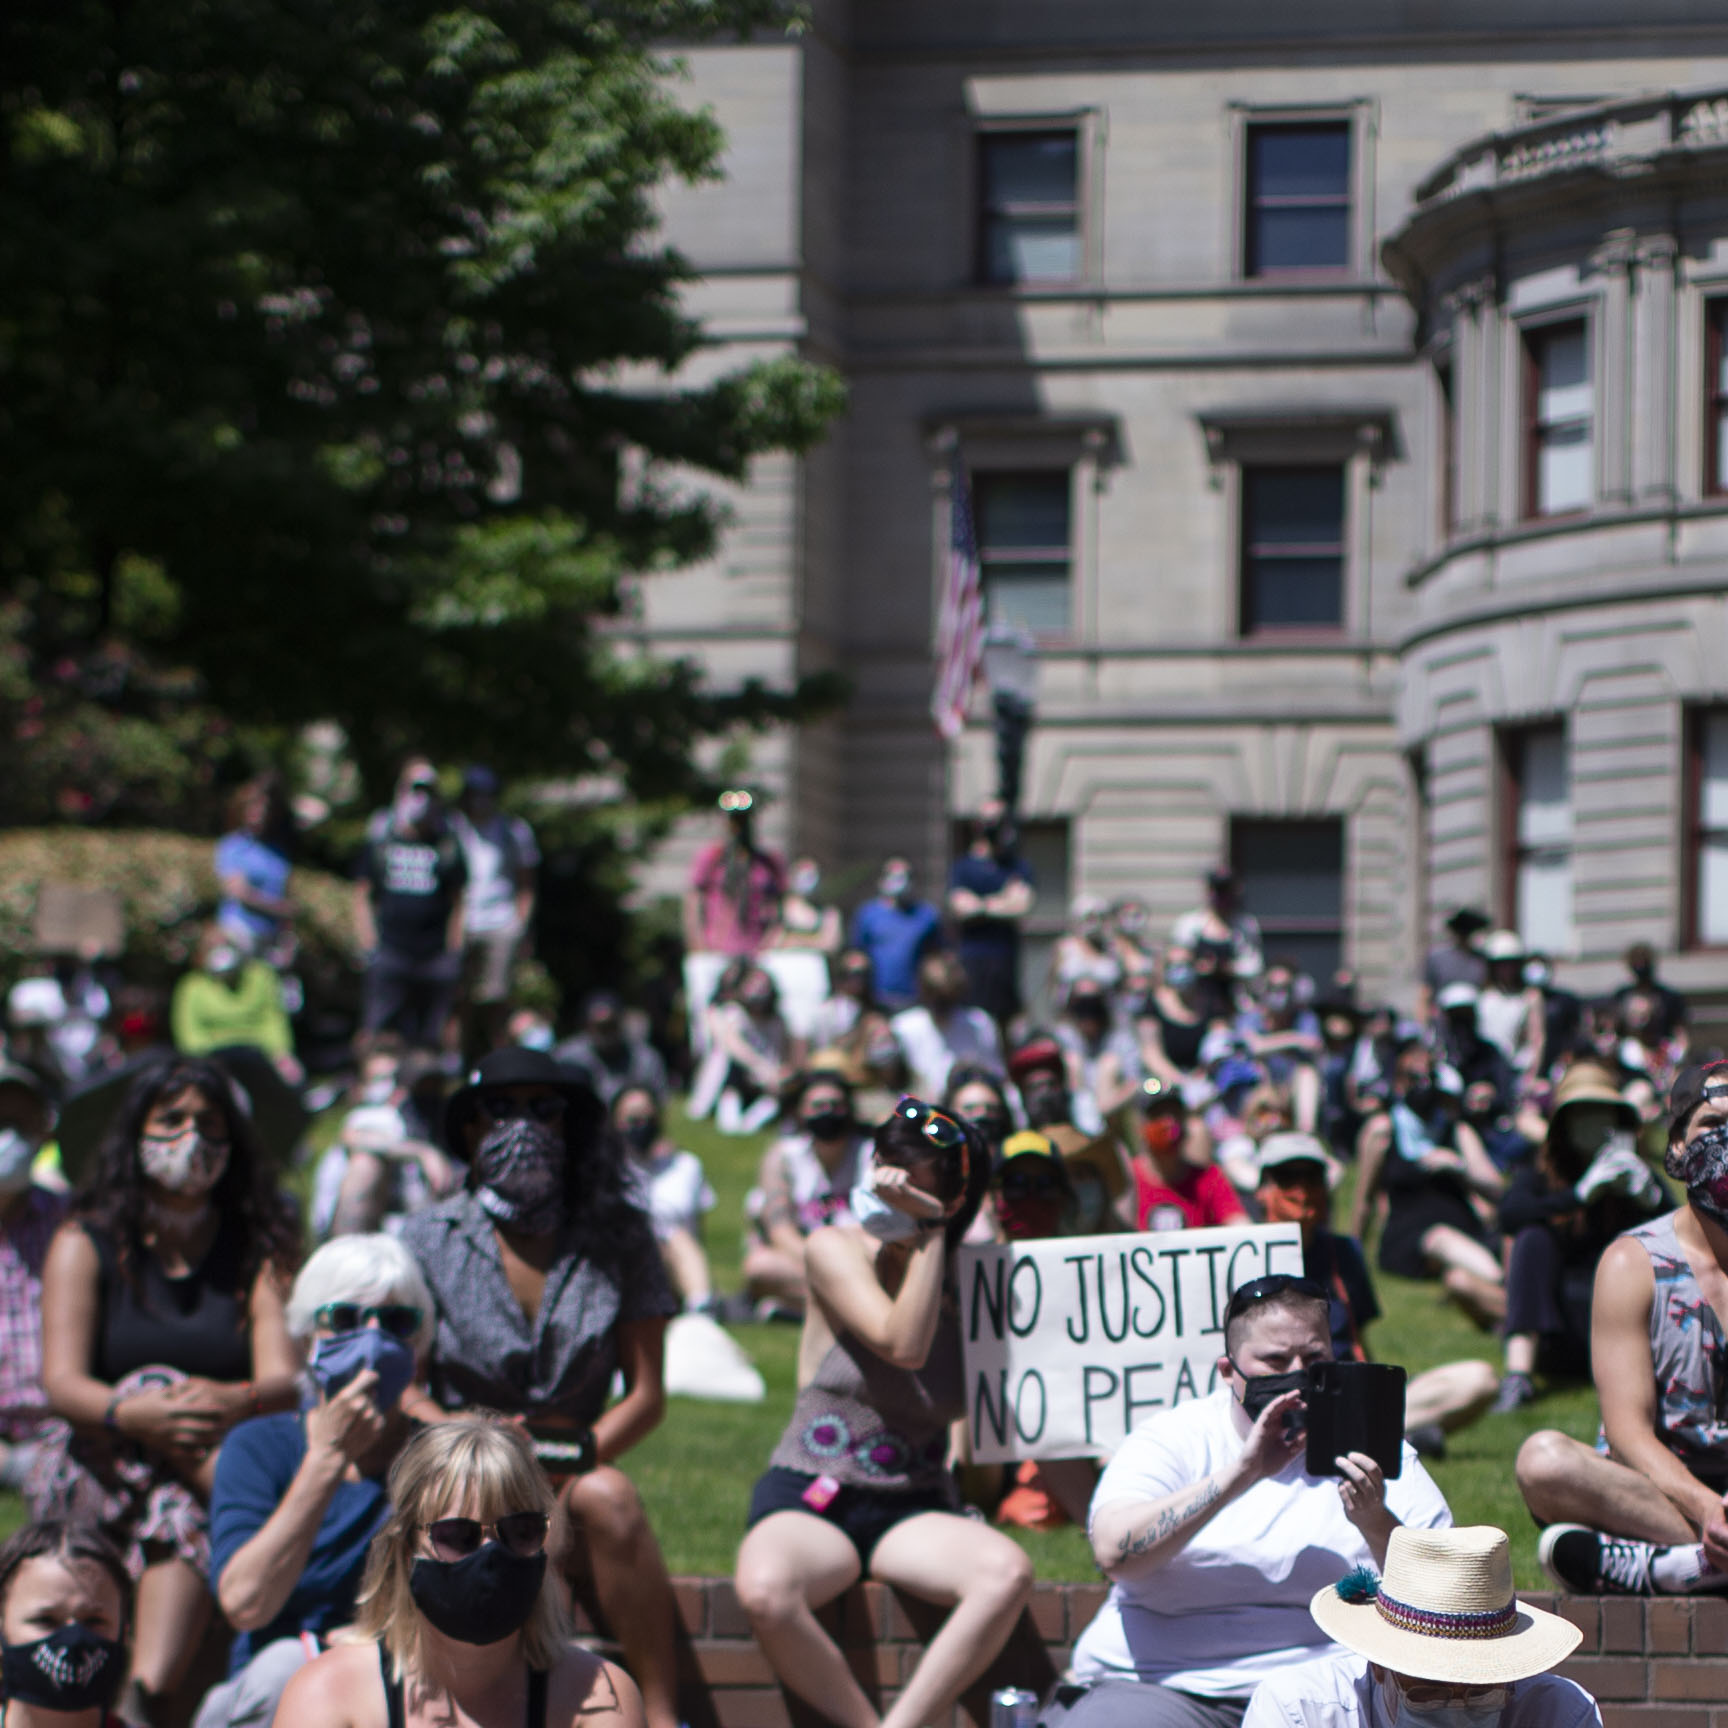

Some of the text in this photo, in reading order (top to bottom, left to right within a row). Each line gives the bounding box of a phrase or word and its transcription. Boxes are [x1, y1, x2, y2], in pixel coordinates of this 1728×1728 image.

[970, 1255, 1043, 1342] NO
[974, 1356, 1221, 1450] NO PEA
